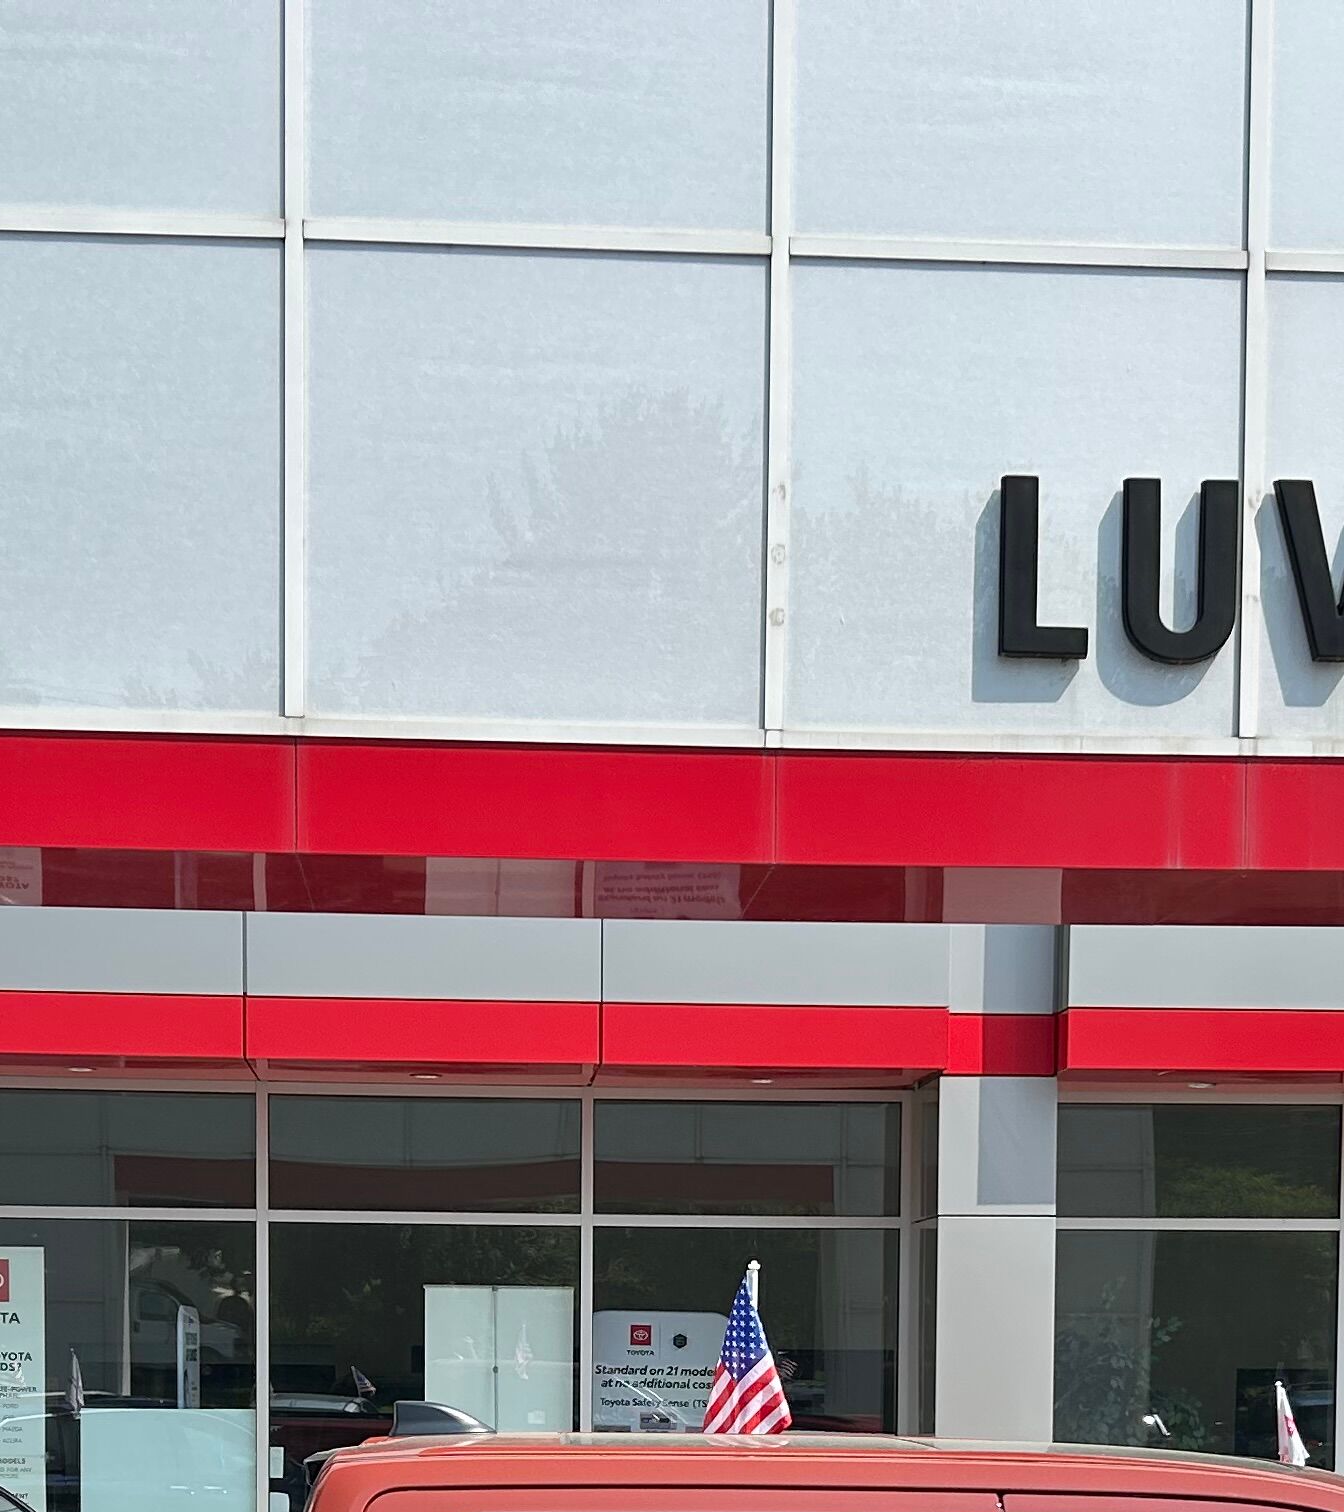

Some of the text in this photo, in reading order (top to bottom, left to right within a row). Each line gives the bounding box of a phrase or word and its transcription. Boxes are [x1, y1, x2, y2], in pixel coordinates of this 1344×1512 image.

[595, 1365, 716, 1377] Standard on 21 mode
[601, 1379, 613, 1387] at
[632, 1378, 690, 1389] additional
[600, 1398, 630, 1408] Toyota
[692, 1399, 708, 1409] (TS
